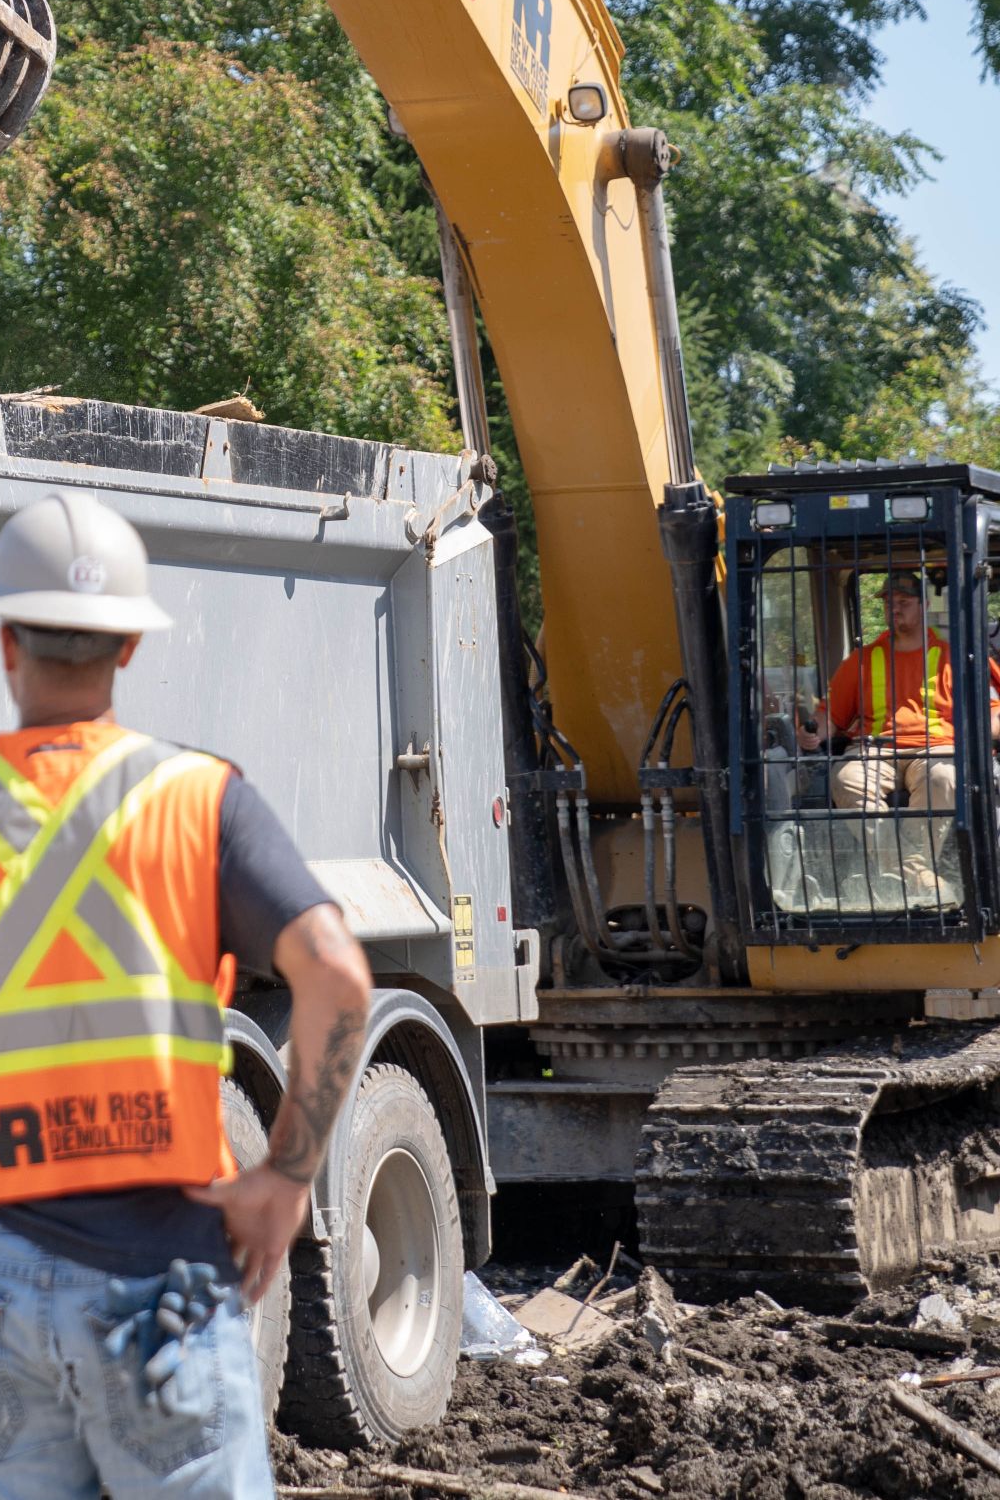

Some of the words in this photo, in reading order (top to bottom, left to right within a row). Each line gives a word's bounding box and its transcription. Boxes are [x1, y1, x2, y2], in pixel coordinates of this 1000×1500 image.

[45, 1094, 98, 1126] NEW
[108, 1091, 170, 1122] RISE
[49, 1120, 173, 1153] DEMOLITION
